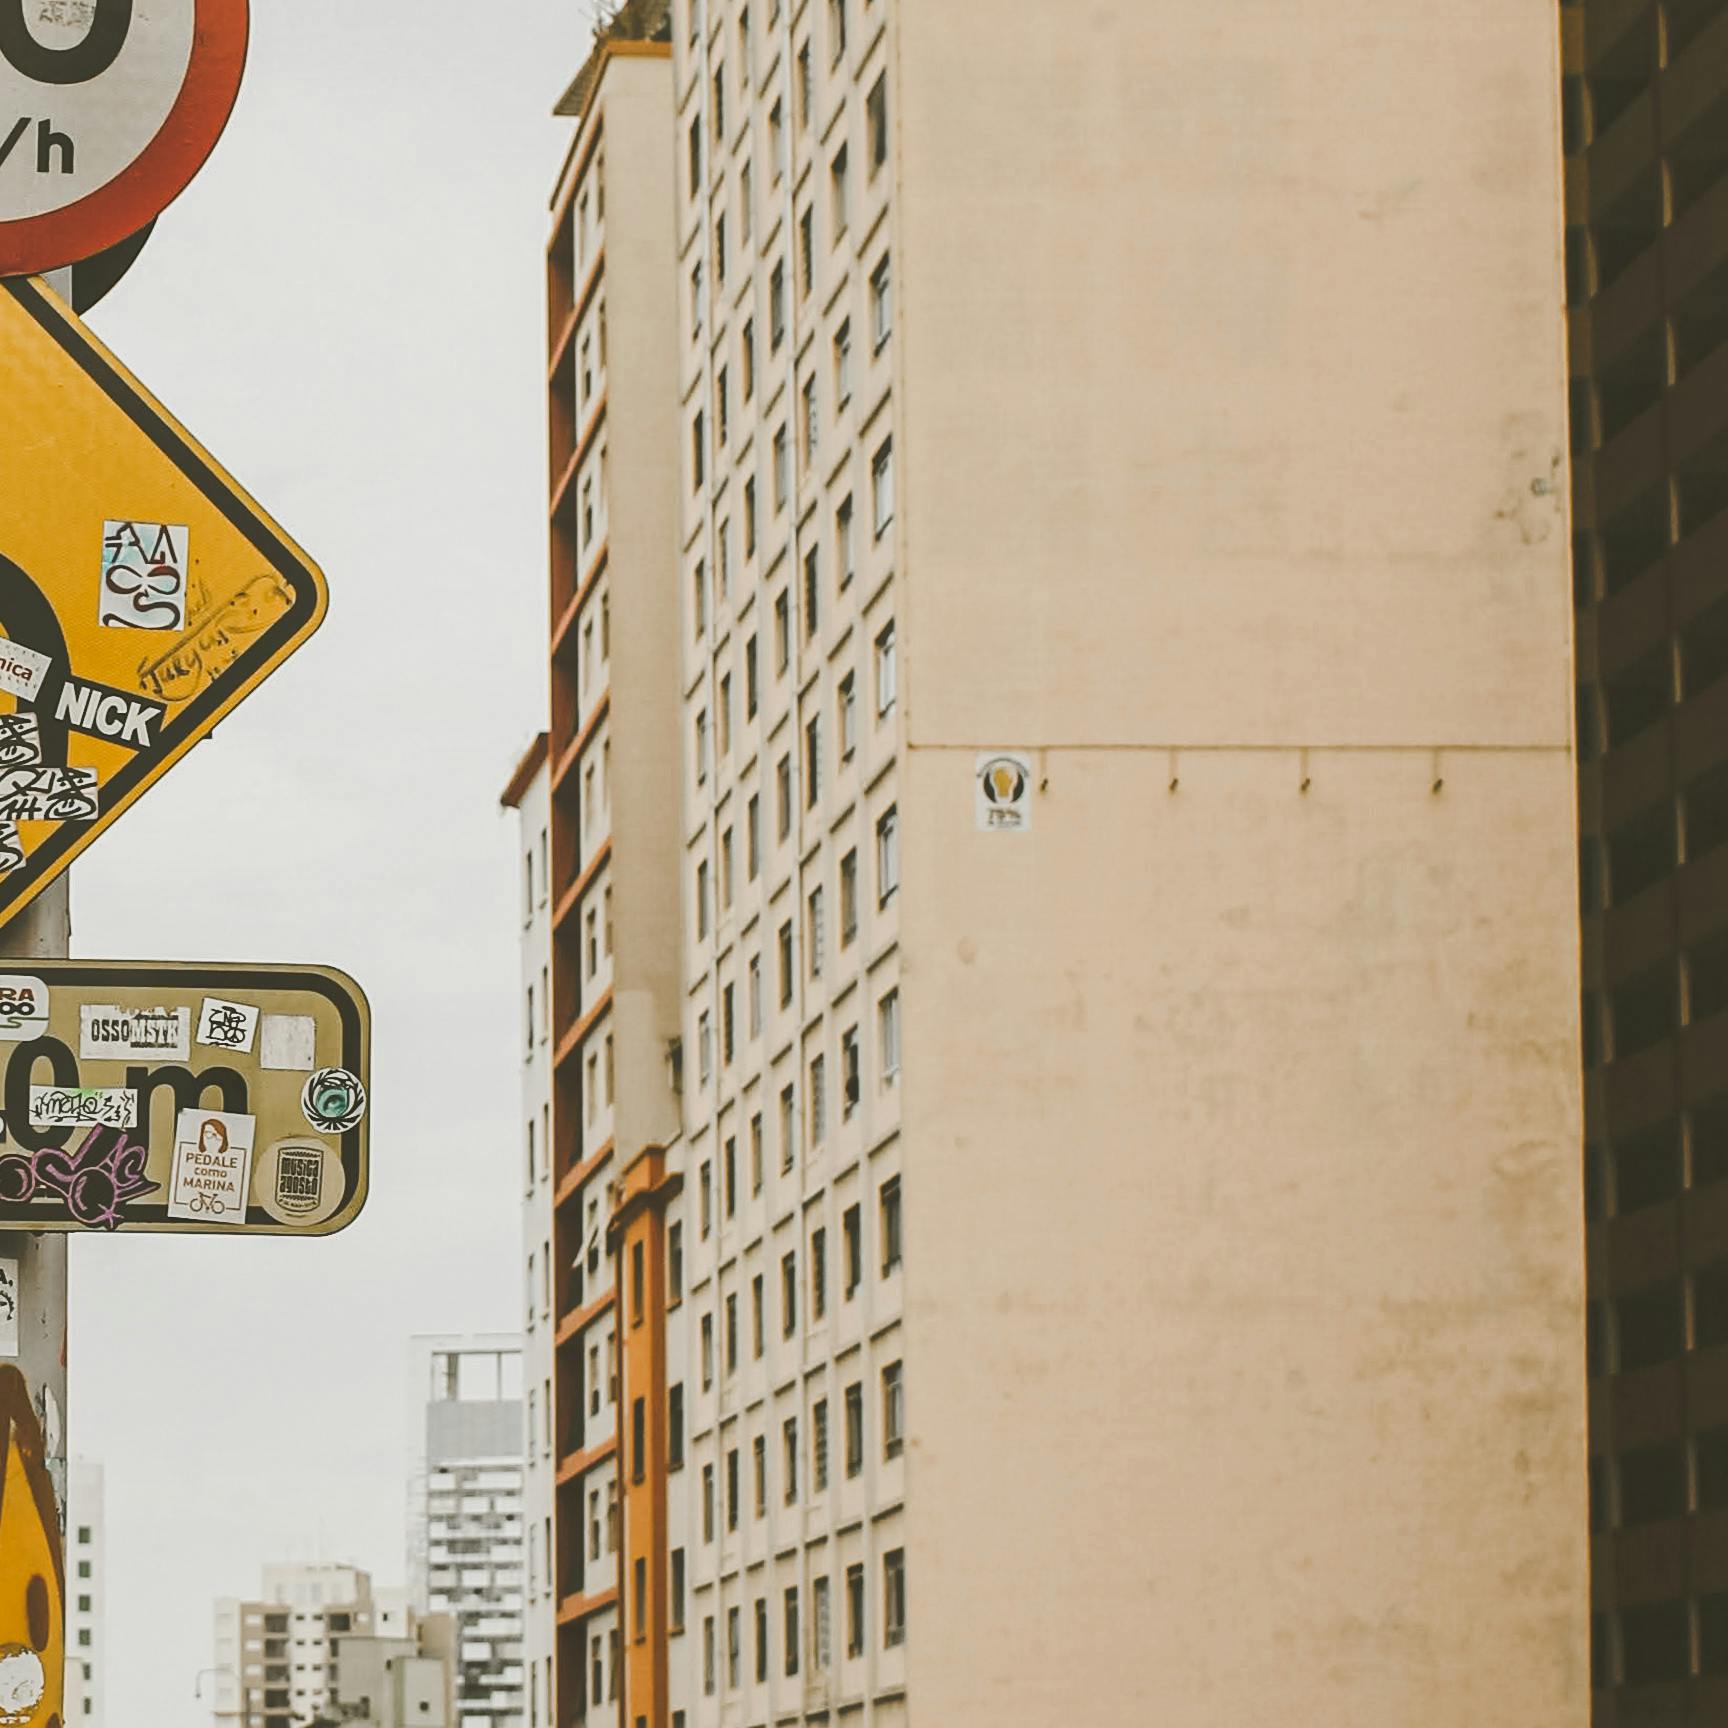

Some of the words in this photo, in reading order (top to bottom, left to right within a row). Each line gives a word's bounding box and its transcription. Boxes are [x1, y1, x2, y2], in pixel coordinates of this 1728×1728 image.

[54, 681, 162, 748] NICK
[125, 1065, 248, 1156] m
[185, 1152, 239, 1170] PEDALE
[182, 1176, 236, 1193] MARINA
